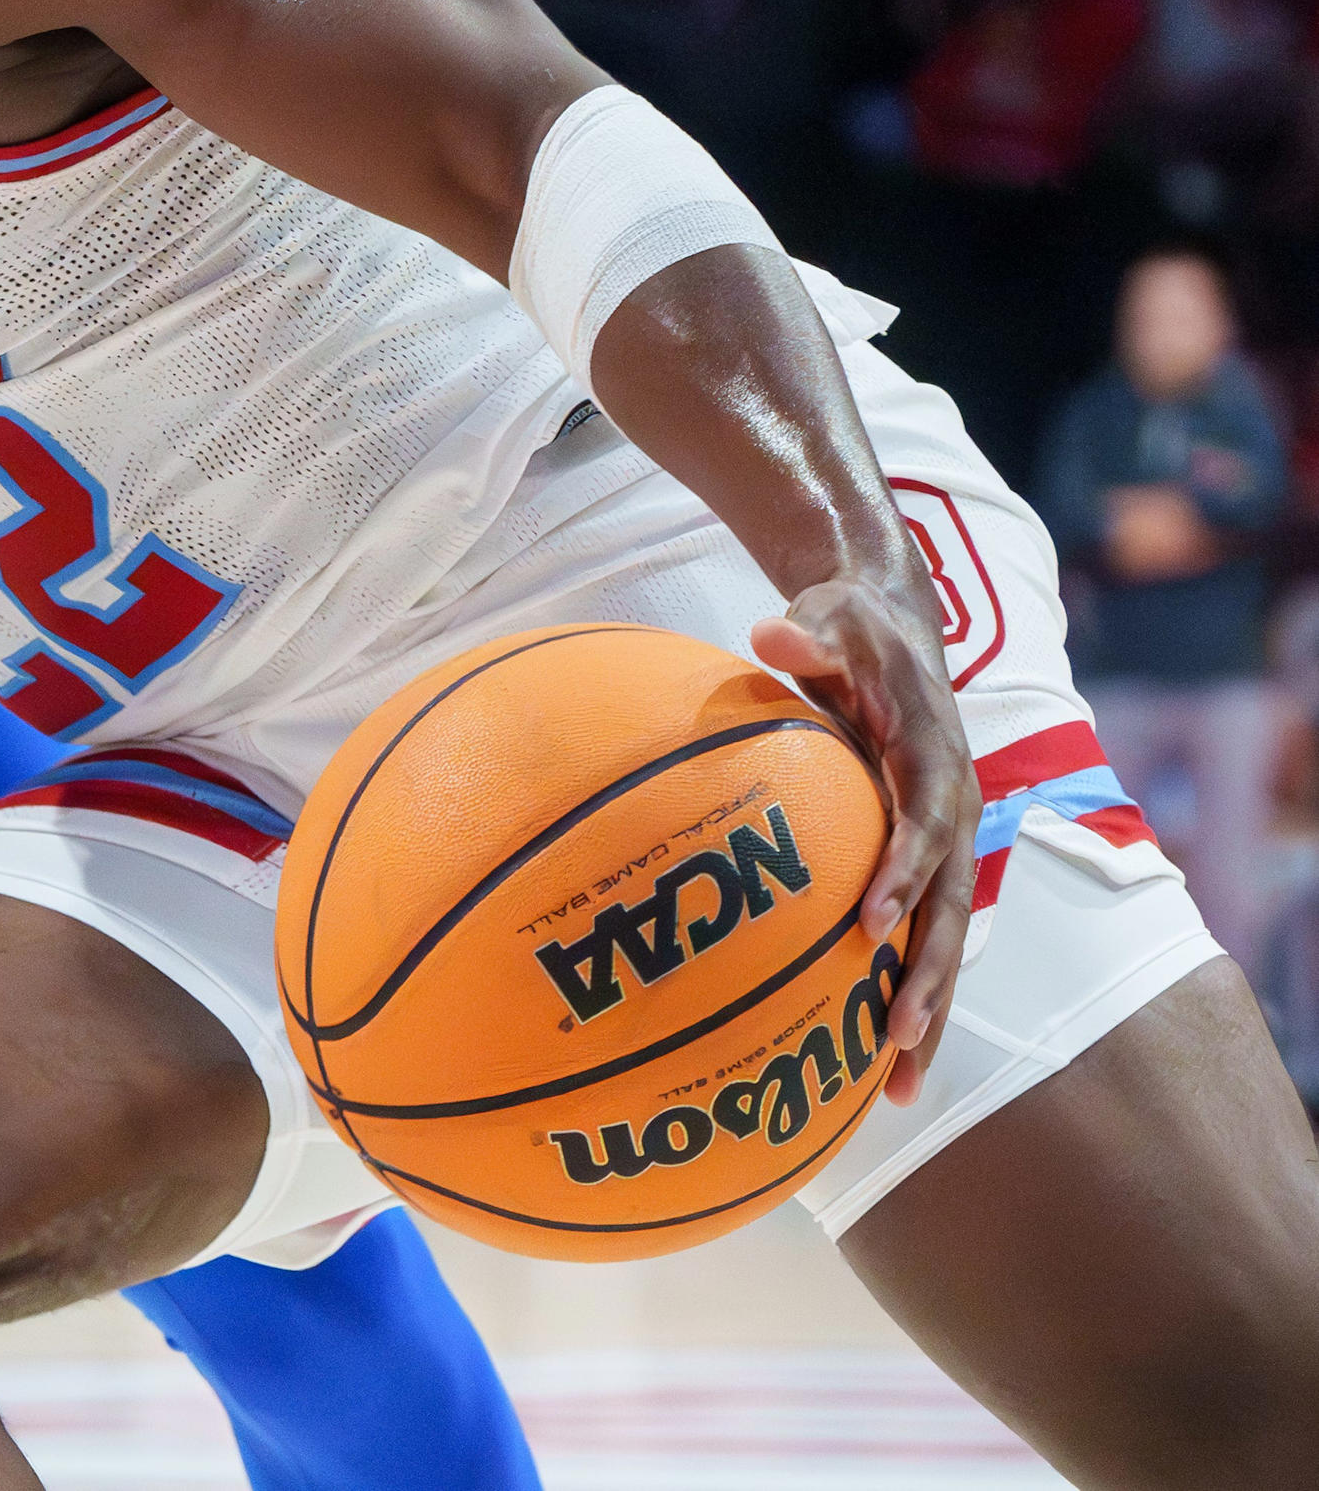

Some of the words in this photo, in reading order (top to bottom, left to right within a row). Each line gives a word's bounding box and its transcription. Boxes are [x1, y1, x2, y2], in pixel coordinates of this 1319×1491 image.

[592, 843, 671, 896] GAME
[516, 892, 591, 935] BALL
[533, 800, 813, 1026] NCAA
[772, 994, 832, 1048] INDOOR
[547, 942, 905, 1186] Wilson
[657, 1076, 711, 1101] BALL
[714, 1045, 768, 1080] GAME
